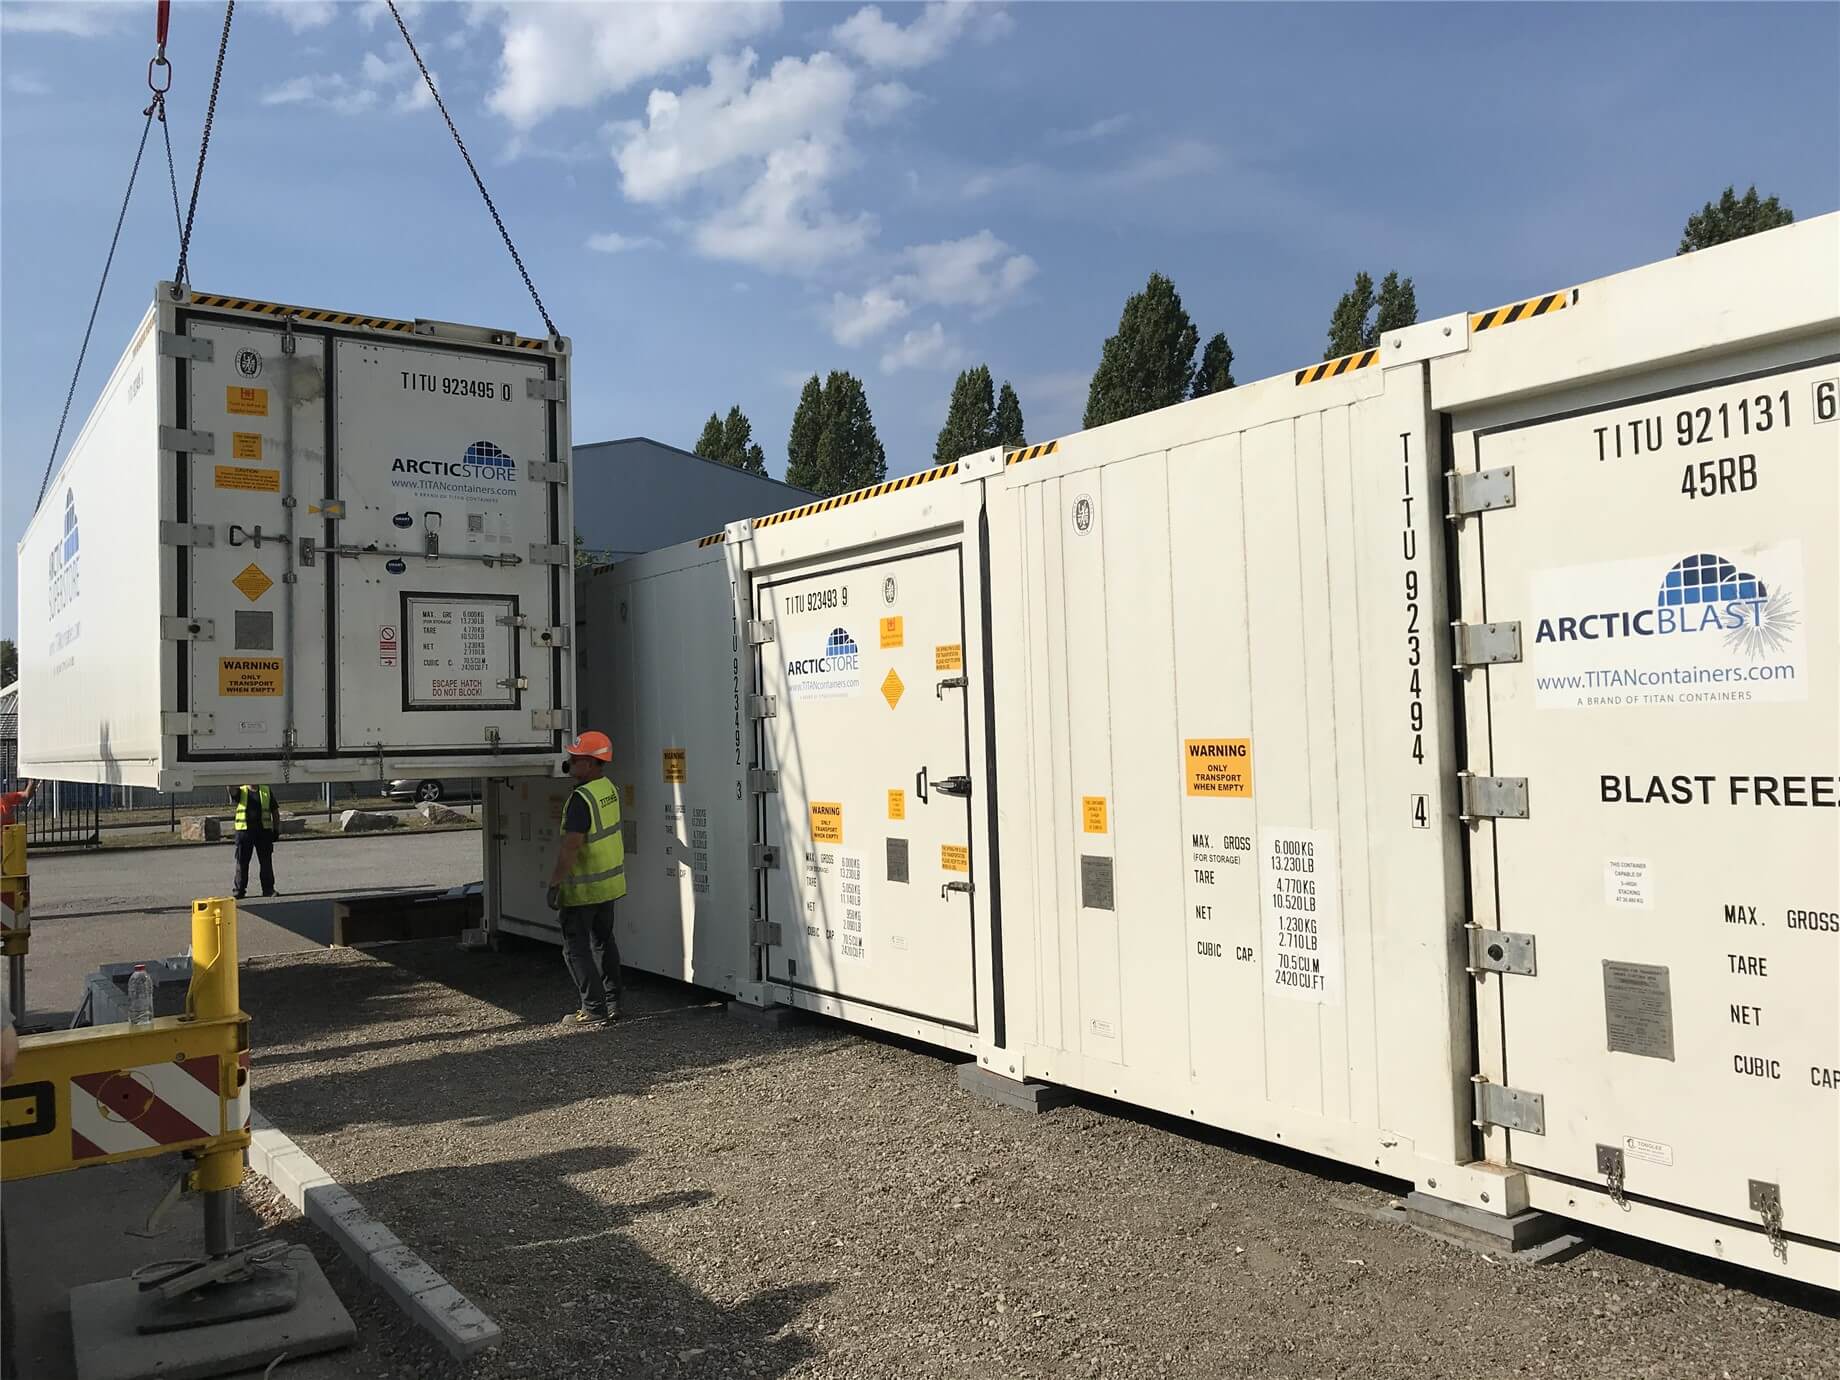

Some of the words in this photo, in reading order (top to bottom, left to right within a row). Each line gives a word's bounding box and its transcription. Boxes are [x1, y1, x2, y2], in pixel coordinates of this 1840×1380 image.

[401, 371, 436, 392] TITU
[442, 377, 494, 399] 923495
[502, 384, 511, 401] 0
[1593, 415, 1664, 461] TITU
[1676, 389, 1792, 446] 921131
[1816, 381, 1836, 420] 6
[392, 458, 519, 482] ARCTICSTORE
[1681, 452, 1758, 500] 45RB
[391, 479, 517, 497] www.TITANcontainers.com
[1399, 432, 1416, 561] TITU
[785, 593, 804, 615] TITU
[807, 588, 838, 611] 923493
[842, 586, 848, 606] 9
[1535, 598, 1769, 643] ARCTICBLAST
[223, 661, 279, 671] WARNING
[788, 654, 859, 676] ARCTICSTORE
[1405, 570, 1424, 765] 923494
[432, 679, 458, 688] ESCAPE
[460, 679, 482, 688] HATCH
[1536, 664, 1796, 691] www.TITANcontainers.com
[432, 688, 443, 697] DO
[444, 688, 457, 697] NOT
[458, 688, 482, 697] BLOCK!
[1577, 698, 1583, 706] A
[1587, 695, 1622, 706] BRAND
[1625, 695, 1640, 705] OF
[1643, 694, 1675, 704] TITAN
[1678, 690, 1753, 703] CONTAINERS
[732, 657, 742, 765] 923492
[1189, 744, 1247, 757] WARNING
[1195, 773, 1242, 782] TRANSPORT
[1207, 764, 1228, 772] ONLY
[1193, 782, 1217, 791] WHEN
[1217, 783, 1245, 792] EMPTY
[1600, 775, 1717, 804] BLAST
[1729, 775, 1840, 807] FREE
[812, 806, 840, 816] WARNING
[1414, 795, 1427, 827] 4
[1192, 834, 1214, 849] MAX.
[1223, 835, 1251, 851] GROSS
[1192, 853, 1208, 864] (FOR
[1209, 853, 1241, 866] STORAGE)
[1194, 869, 1215, 885] TARE
[1195, 905, 1212, 921] NET
[1724, 904, 1766, 927] MAX.
[1787, 909, 1840, 933] GROSS
[1197, 940, 1222, 958] CUBIC
[1235, 946, 1256, 963] CAP.
[1728, 954, 1768, 977] TARE
[1730, 1004, 1762, 1027] NET
[1734, 1054, 1781, 1080] CUBIC
